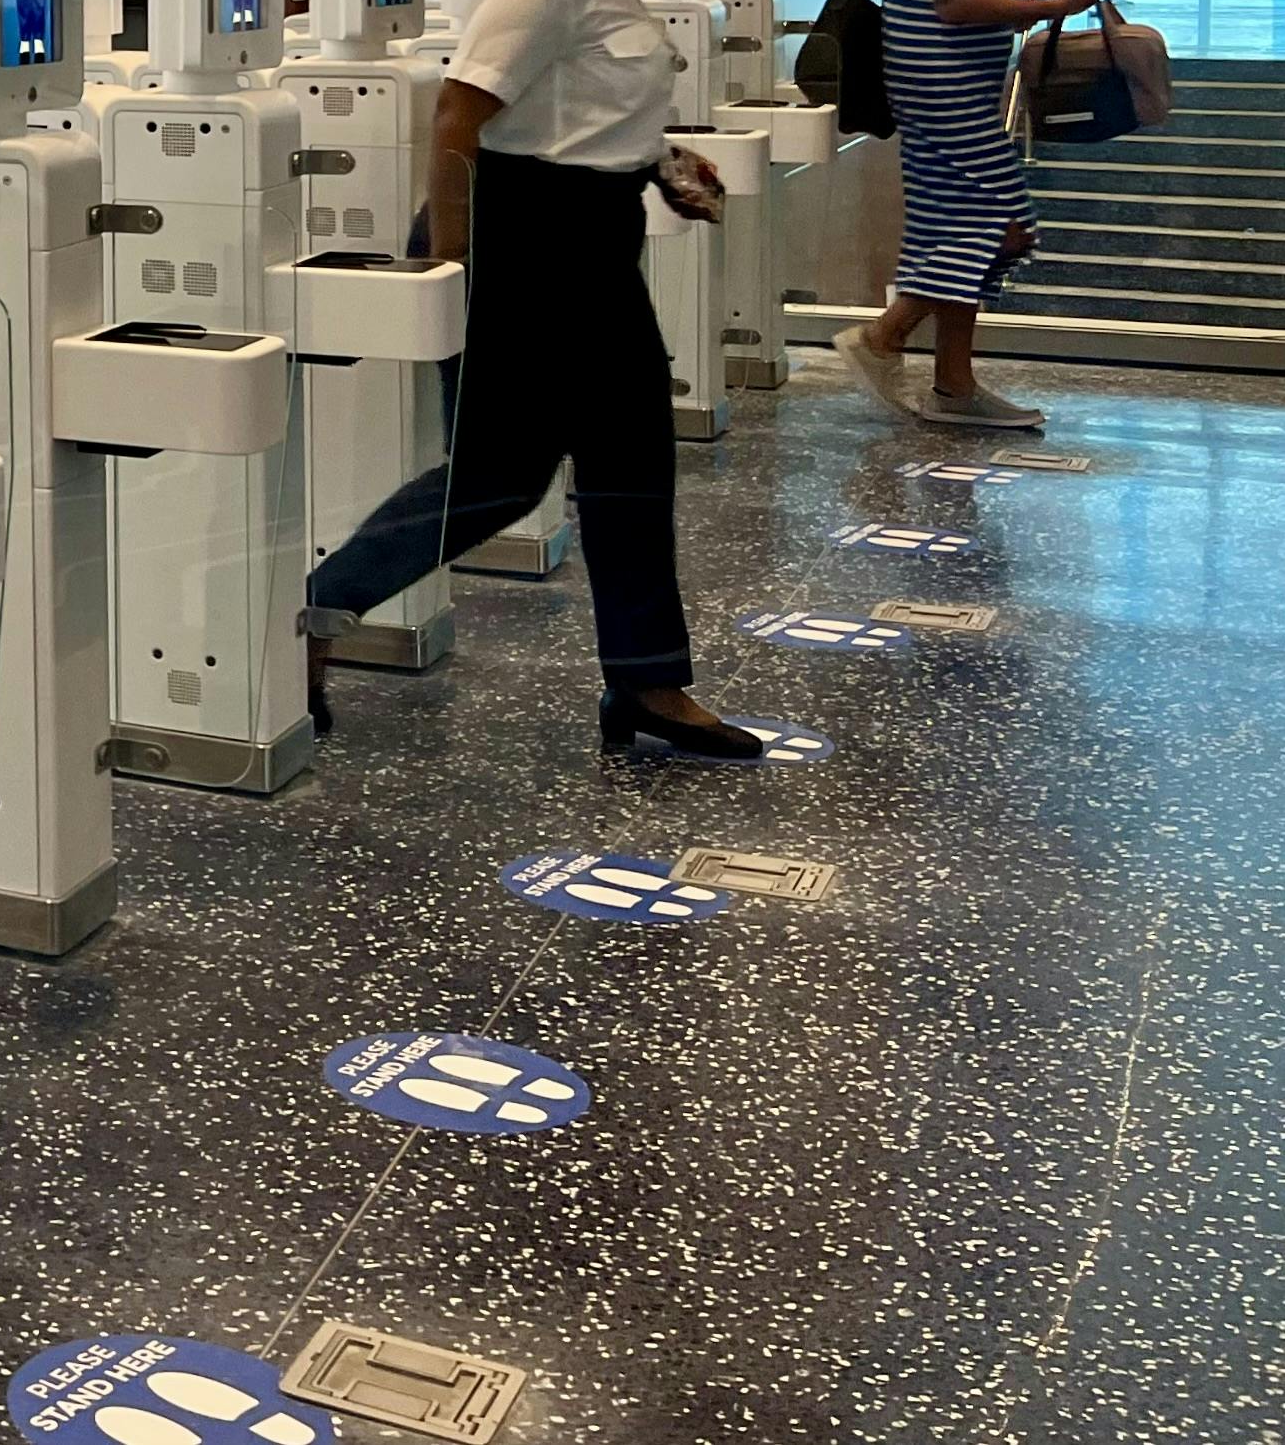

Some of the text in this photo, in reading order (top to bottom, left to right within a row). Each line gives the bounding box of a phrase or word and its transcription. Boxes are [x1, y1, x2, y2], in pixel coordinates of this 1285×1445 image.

[337, 1039, 398, 1077] PLEASE
[350, 1035, 444, 1098] STAND HERE
[25, 1344, 117, 1400] PLEASE
[29, 1339, 177, 1432] STAND HERE
